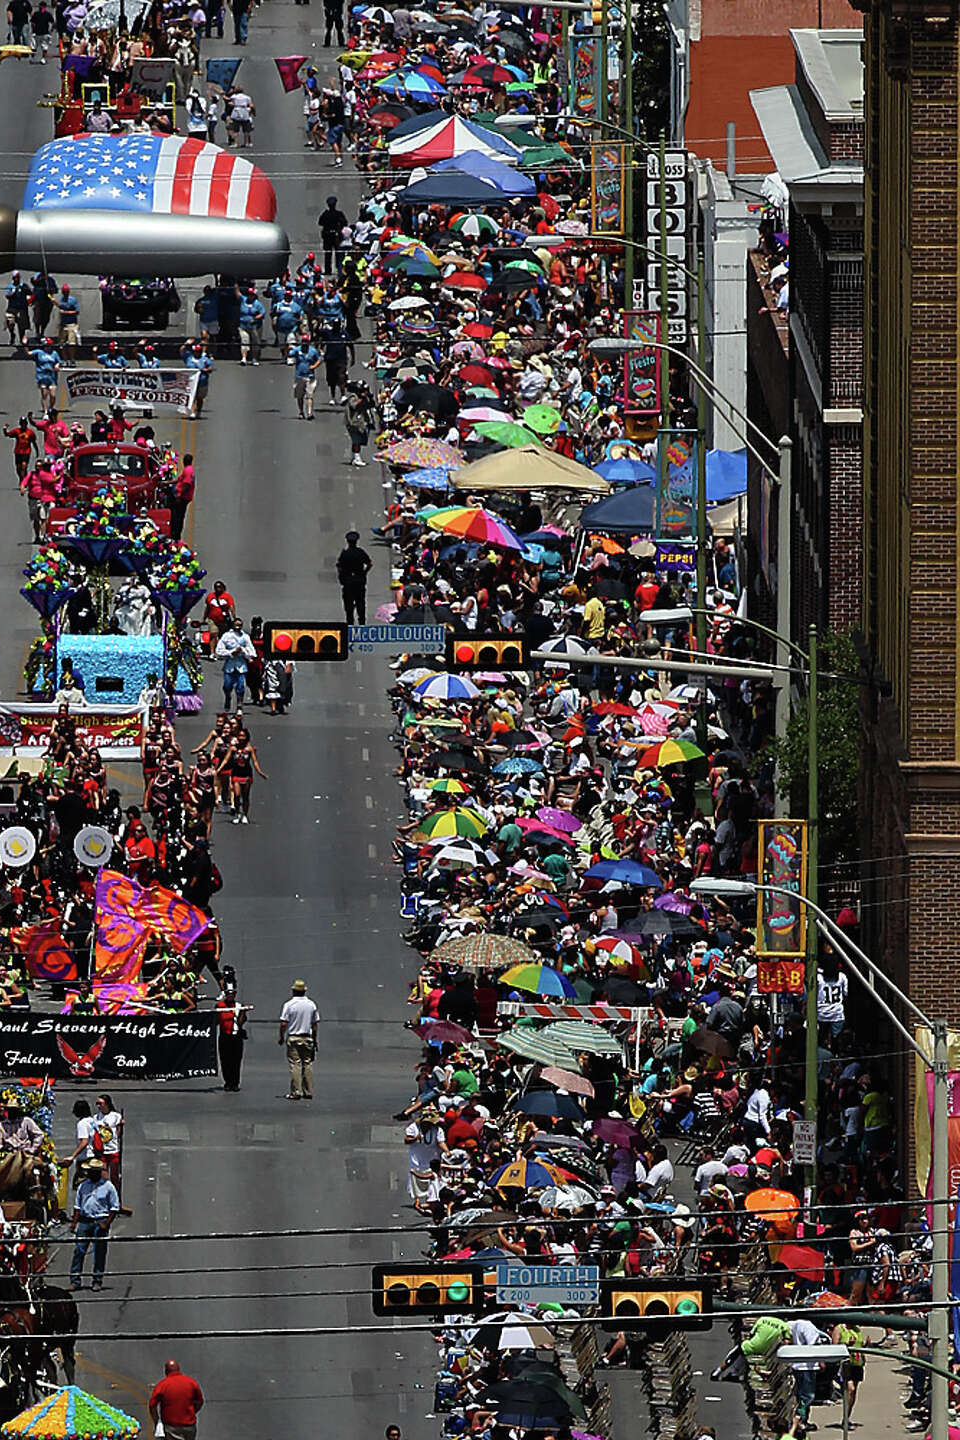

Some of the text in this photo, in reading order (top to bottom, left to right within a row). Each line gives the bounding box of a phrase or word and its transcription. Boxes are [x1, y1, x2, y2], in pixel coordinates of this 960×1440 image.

[630, 356, 656, 370] Fiesta
[72, 387, 189, 405] TETCO STORES
[660, 553, 693, 564] PEPSI
[351, 627, 441, 641] McCULLOUGH
[823, 986, 842, 1003] 12
[32, 1019, 106, 1035] Stevens
[110, 1022, 155, 1038] High
[159, 1022, 211, 1038] School
[4, 1050, 147, 1067] Falcon Band
[507, 1268, 589, 1286] FOURTH
[511, 1291, 586, 1301] 200 300
